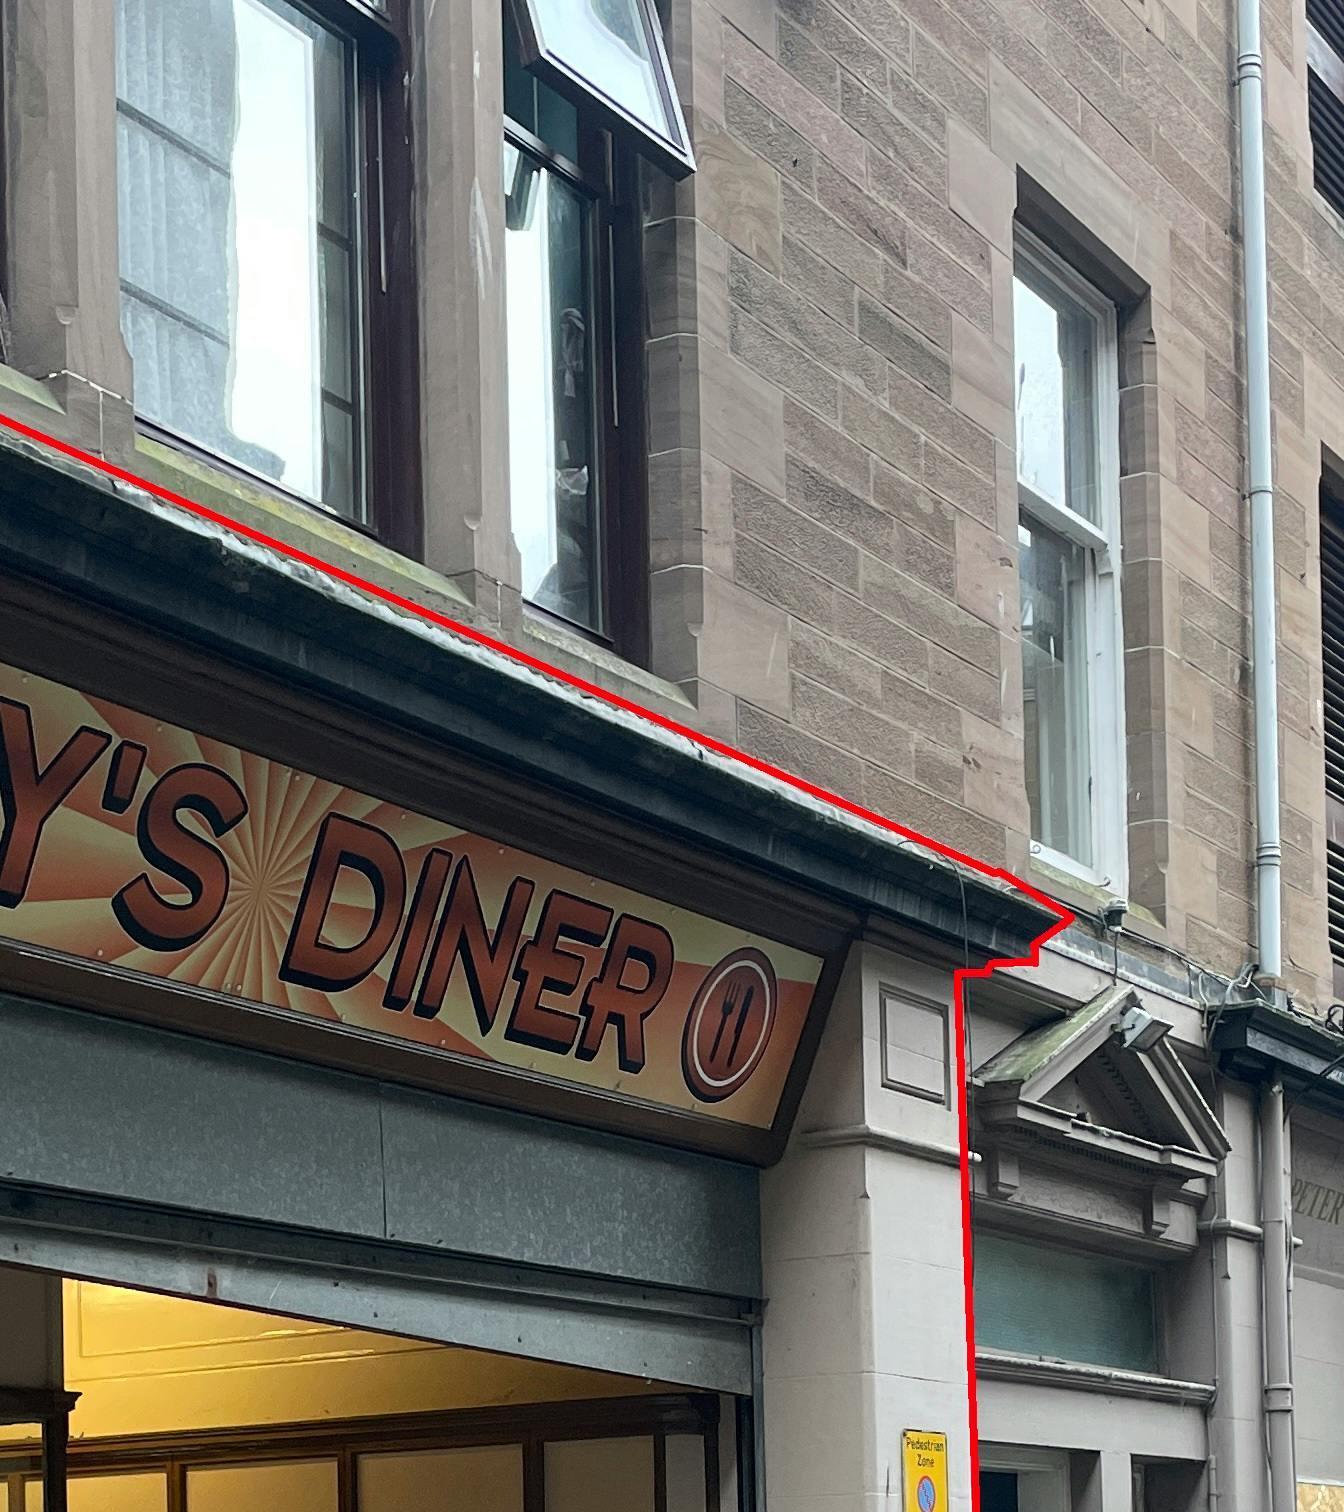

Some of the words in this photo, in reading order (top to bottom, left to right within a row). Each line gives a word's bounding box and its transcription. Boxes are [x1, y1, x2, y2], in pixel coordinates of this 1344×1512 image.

[278, 809, 676, 1074] DINER
[905, 1436, 945, 1453] Pedestrian
[917, 1453, 935, 1469] Zone
